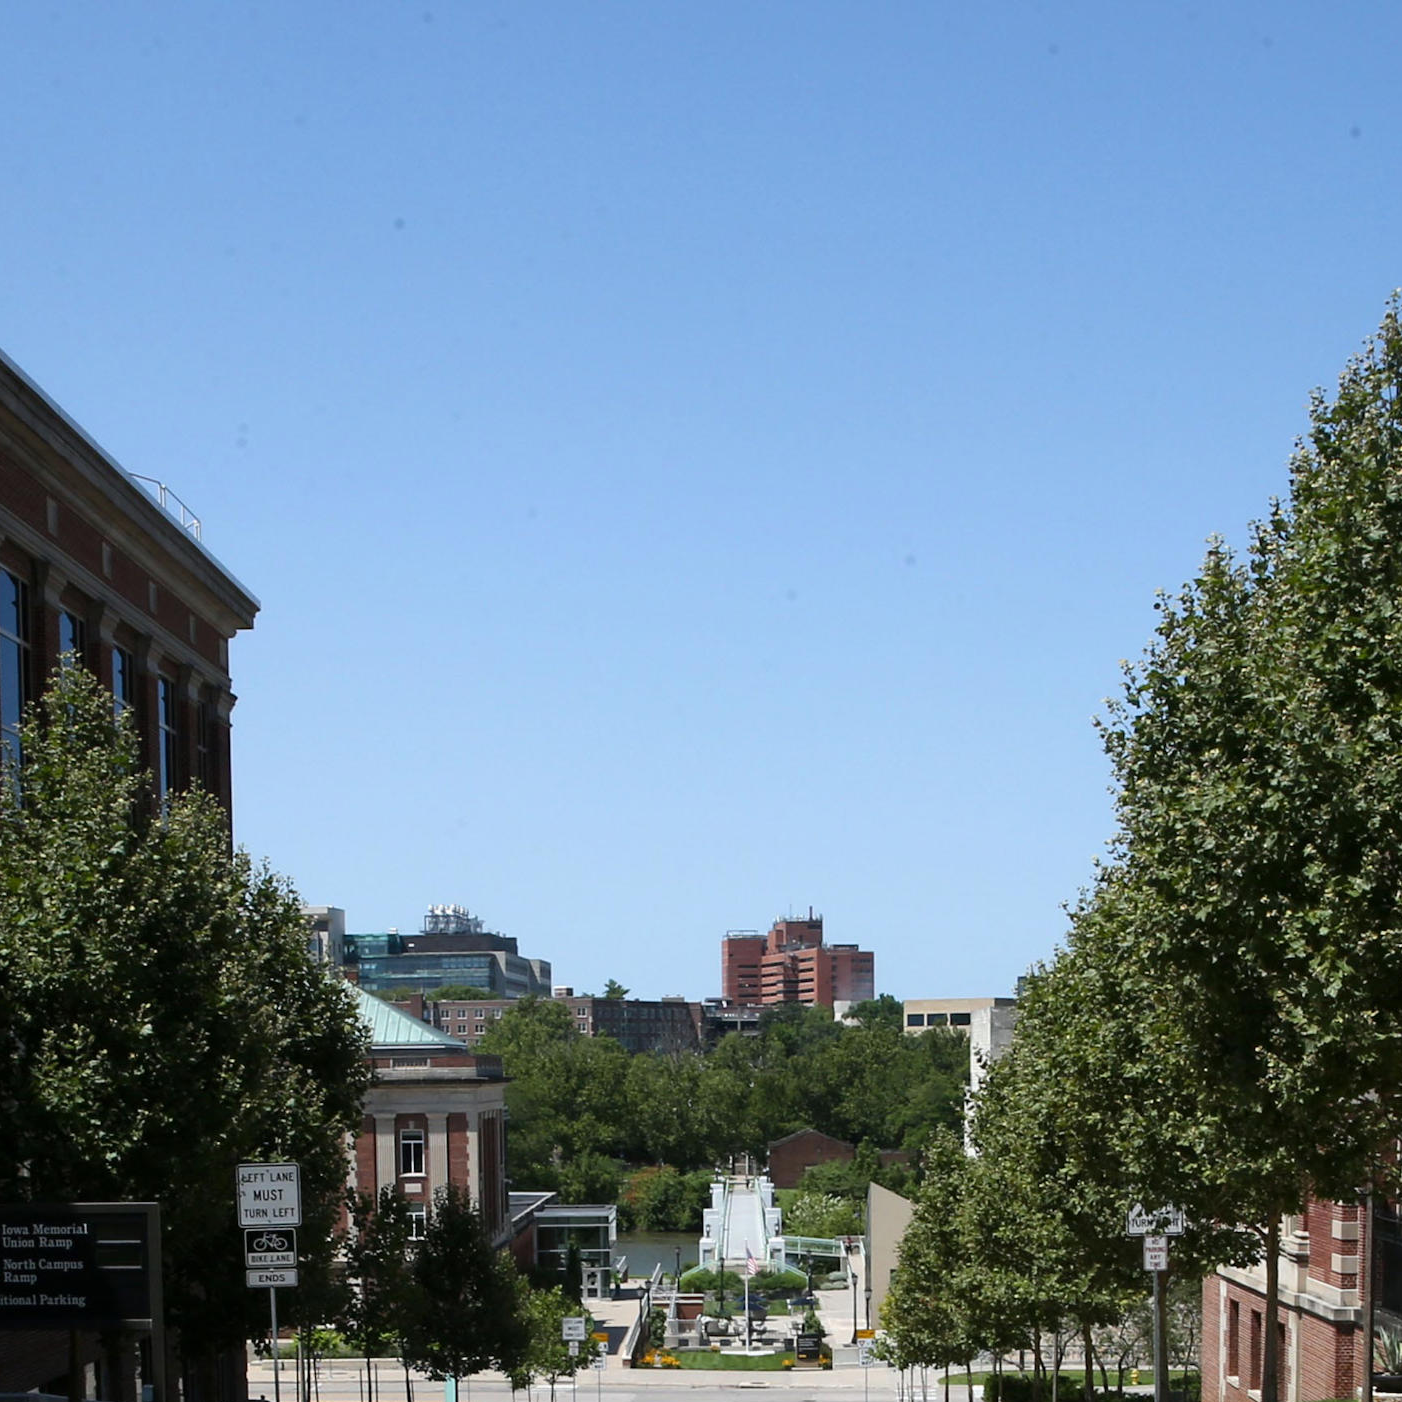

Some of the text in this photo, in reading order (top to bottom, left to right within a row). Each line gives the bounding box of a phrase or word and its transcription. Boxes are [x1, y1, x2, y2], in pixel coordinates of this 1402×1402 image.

[241, 1172, 294, 1183] LEFT LANE
[253, 1189, 284, 1201] MUST
[244, 1207, 295, 1218] TURN LEFT
[2, 1223, 88, 1235] Iowa Memorial
[2, 1236, 73, 1250] Union Ramp
[251, 1254, 291, 1263] BIKE LANE
[3, 1258, 84, 1272] North Campus
[3, 1272, 38, 1285] Ramp
[258, 1274, 286, 1283] ENDS
[39, 1294, 86, 1308] Parking
